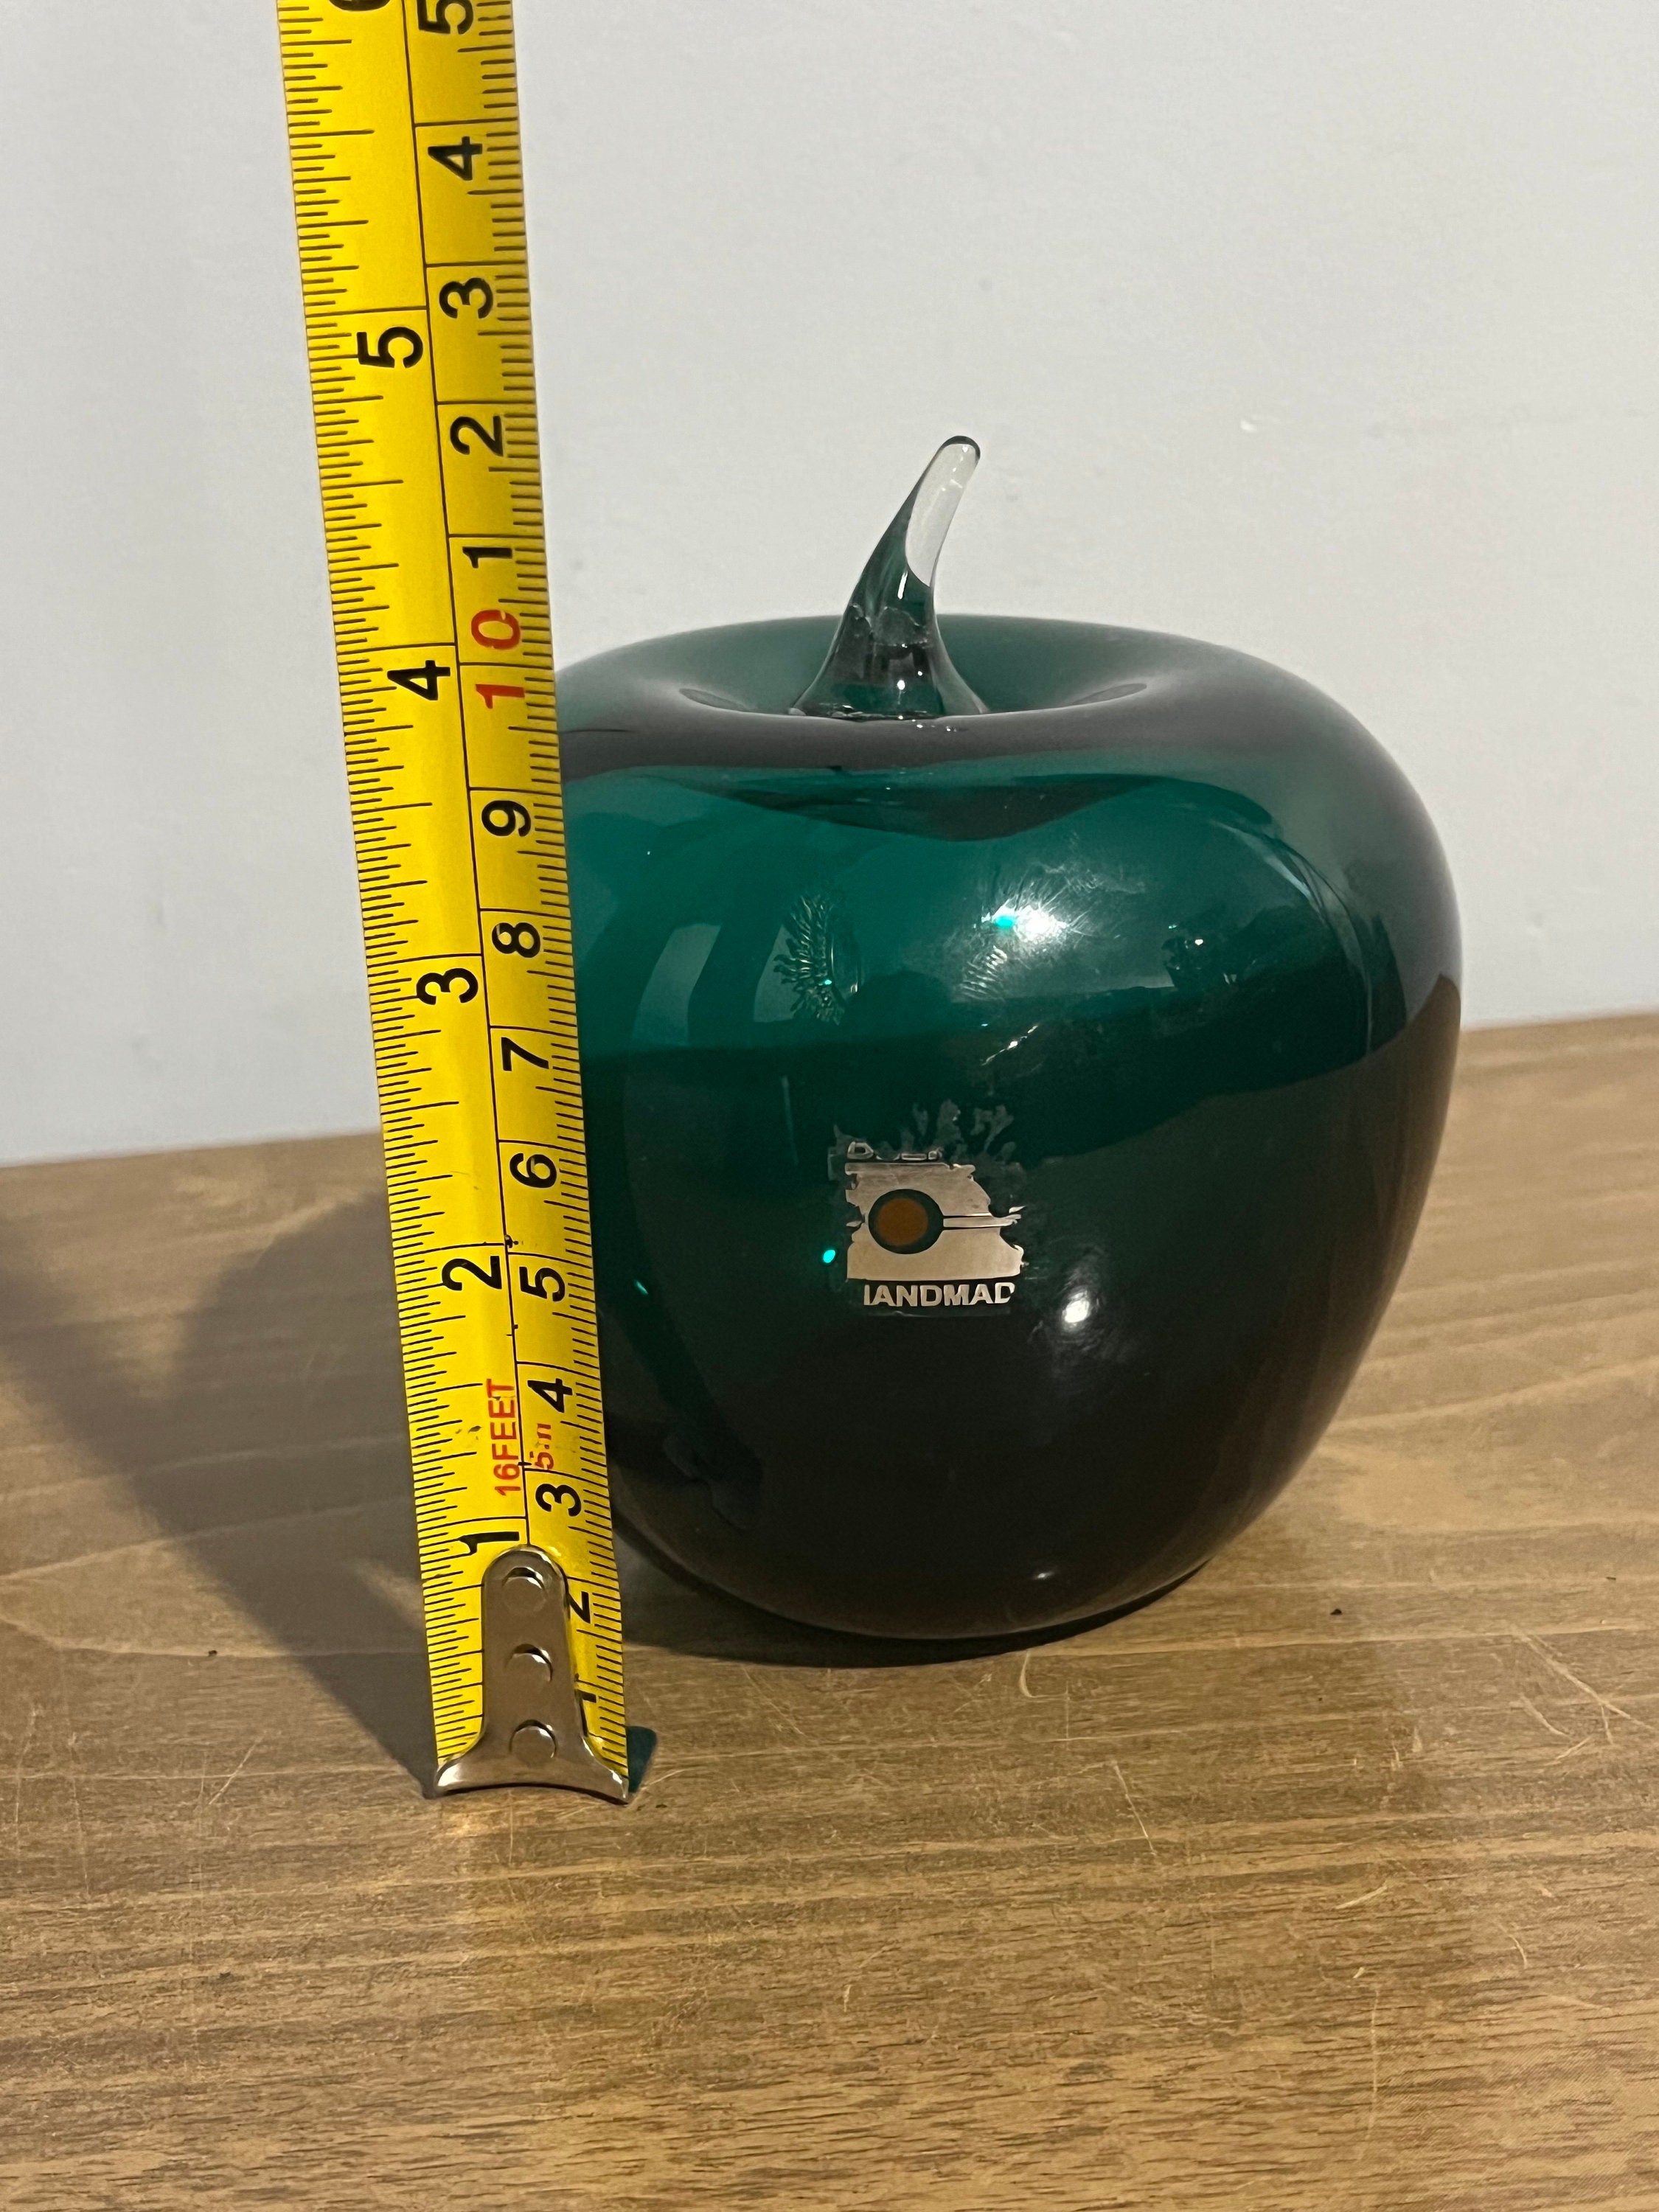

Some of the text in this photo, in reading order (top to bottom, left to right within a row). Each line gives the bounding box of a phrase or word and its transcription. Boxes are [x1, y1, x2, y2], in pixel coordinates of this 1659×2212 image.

[417, 0, 473, 34] 5
[428, 136, 482, 181] 4
[439, 277, 493, 319] 3
[357, 327, 423, 368] 5
[450, 415, 504, 456] 2
[462, 546, 512, 568] 1
[387, 660, 451, 700] 4
[481, 800, 531, 837] 9
[492, 922, 540, 958] 8
[416, 968, 479, 1005] 3
[501, 1037, 549, 1071] 7
[509, 1152, 557, 1189] 6
[442, 1256, 502, 1290] 2
[519, 1266, 566, 1301] 5
[527, 1378, 573, 1413] 4
[486, 1378, 521, 1496] 16FEET
[535, 1484, 582, 1517] 3
[459, 1531, 520, 1554] 1
